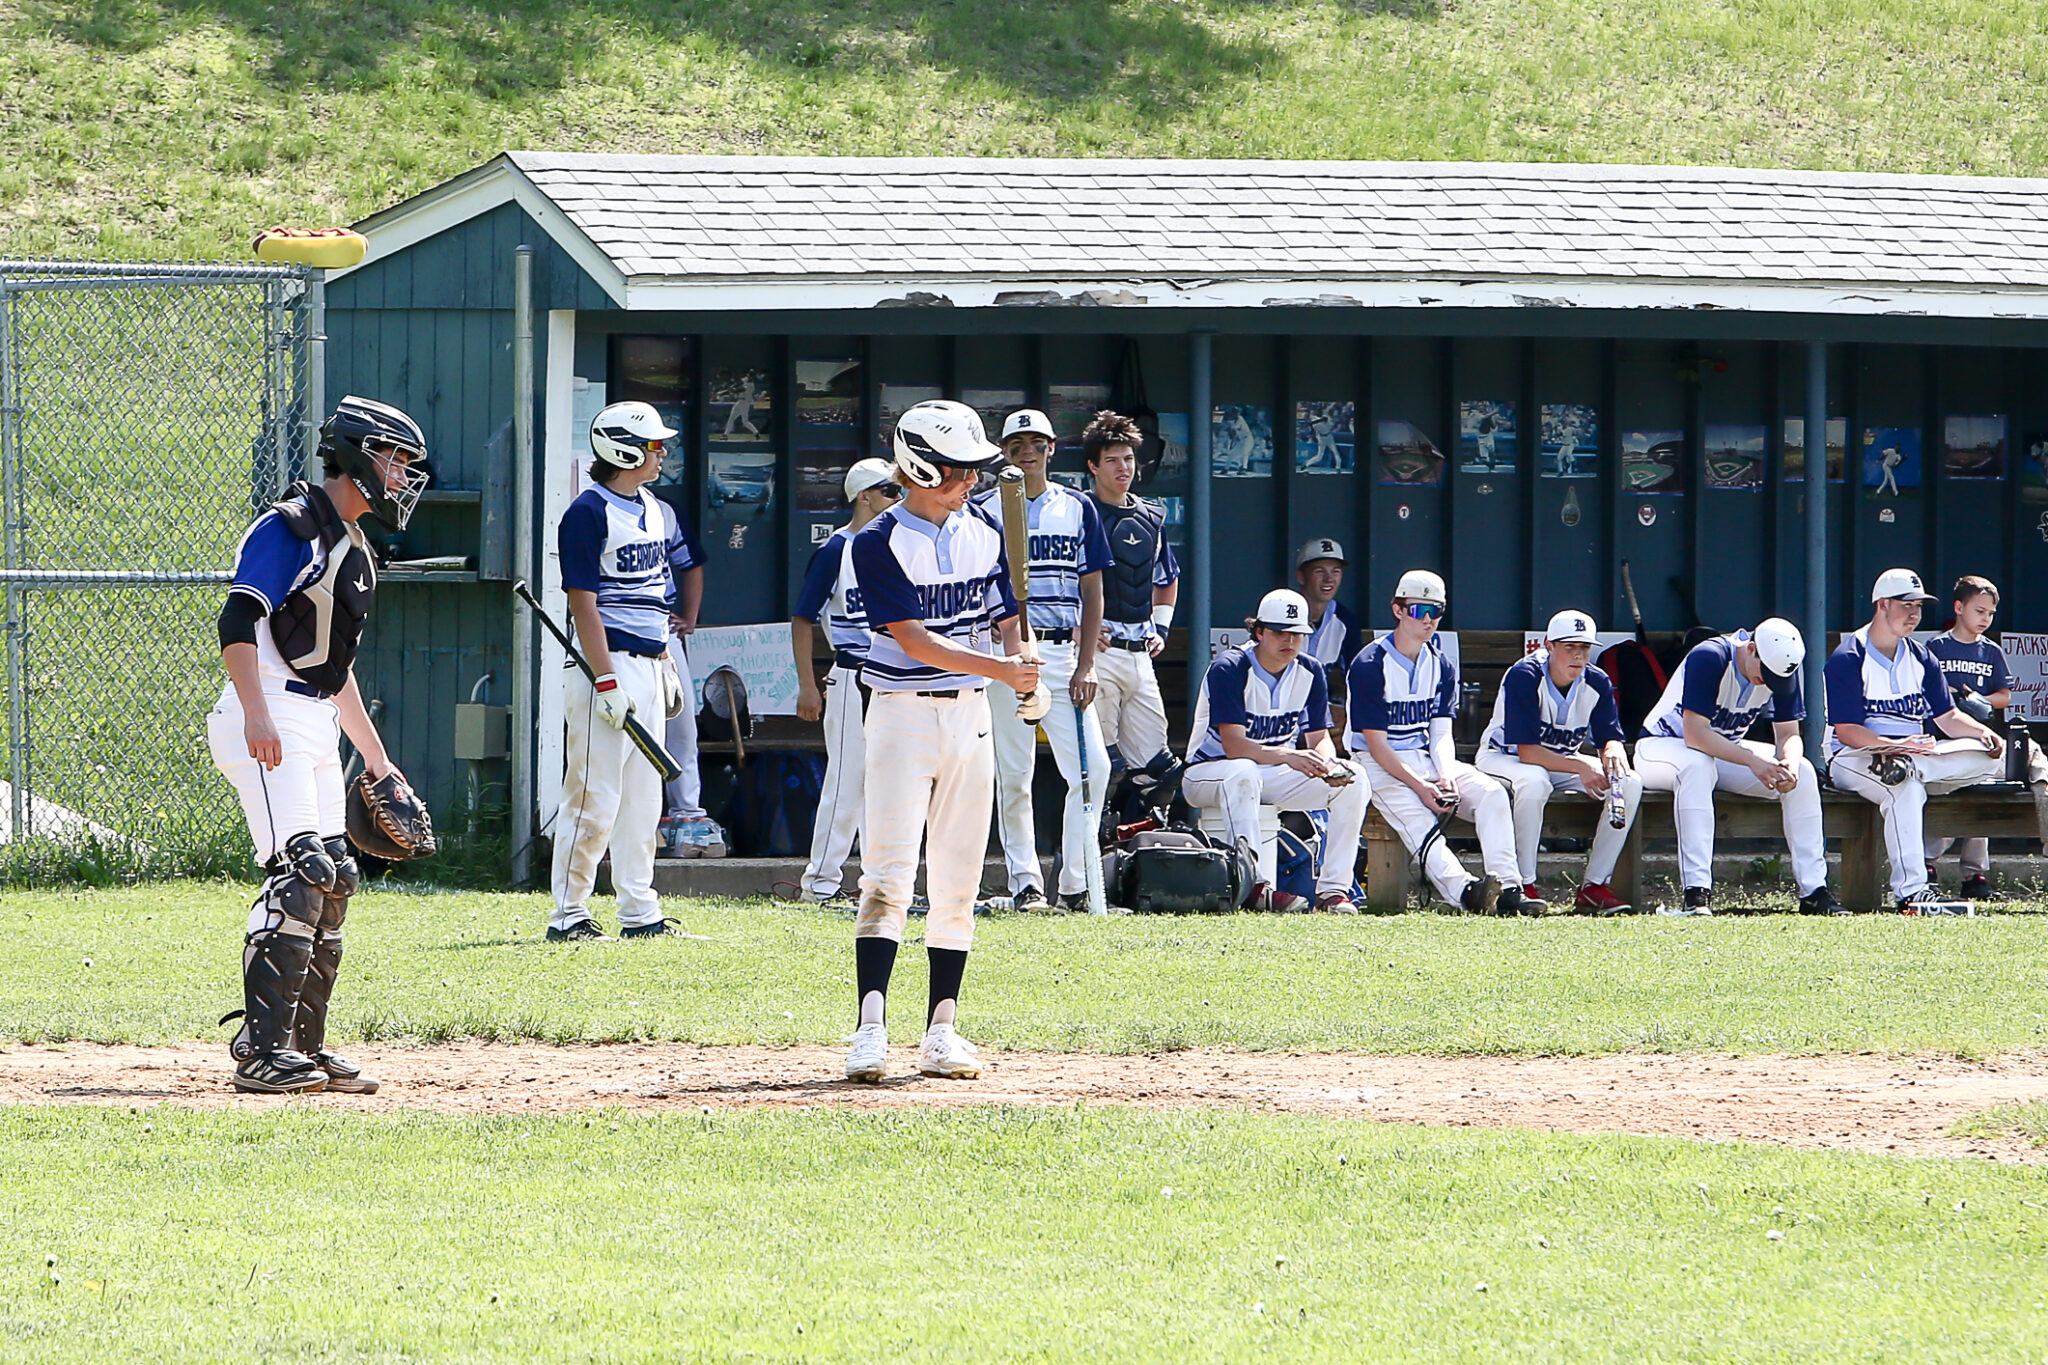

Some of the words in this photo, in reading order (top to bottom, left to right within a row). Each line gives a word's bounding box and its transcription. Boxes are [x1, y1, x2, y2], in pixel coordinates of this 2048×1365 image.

[1018, 414, 1031, 429] B
[1028, 534, 1079, 561] ORSES
[1320, 540, 1335, 553] B
[1285, 603, 1299, 619] B
[1574, 618, 1587, 632] B
[2002, 636, 2048, 656] JACKS
[1938, 659, 1993, 677] EAHORSES
[2012, 676, 2047, 698] lways
